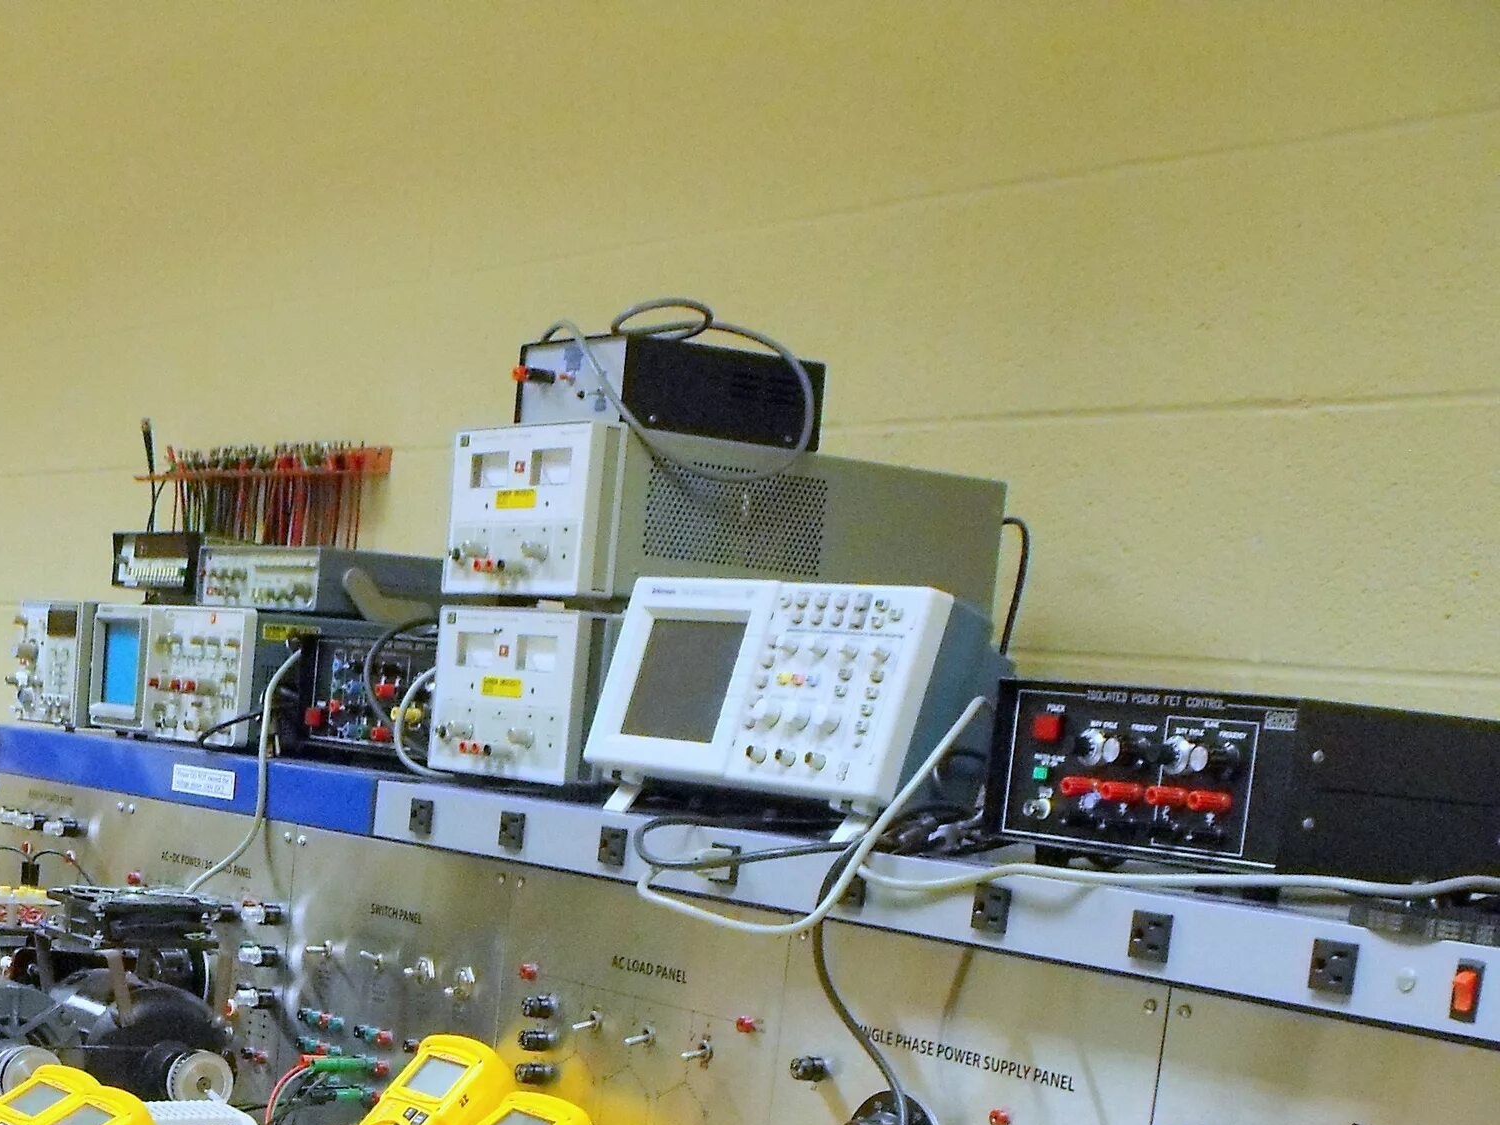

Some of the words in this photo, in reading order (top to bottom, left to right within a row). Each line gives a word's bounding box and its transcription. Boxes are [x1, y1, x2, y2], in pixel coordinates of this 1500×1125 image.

[1131, 693, 1159, 705] POWER
[1185, 697, 1226, 710] CONTROL
[371, 903, 398, 919] SWITCH
[399, 909, 422, 924] PANEL
[611, 955, 625, 970] AC
[626, 958, 654, 975] LOAD
[655, 964, 687, 984] PANEL
[895, 1033, 934, 1056] PHASE
[936, 1044, 981, 1068] POWER
[984, 1055, 1031, 1080] SUPPLY
[1032, 1067, 1075, 1092] PANEL
